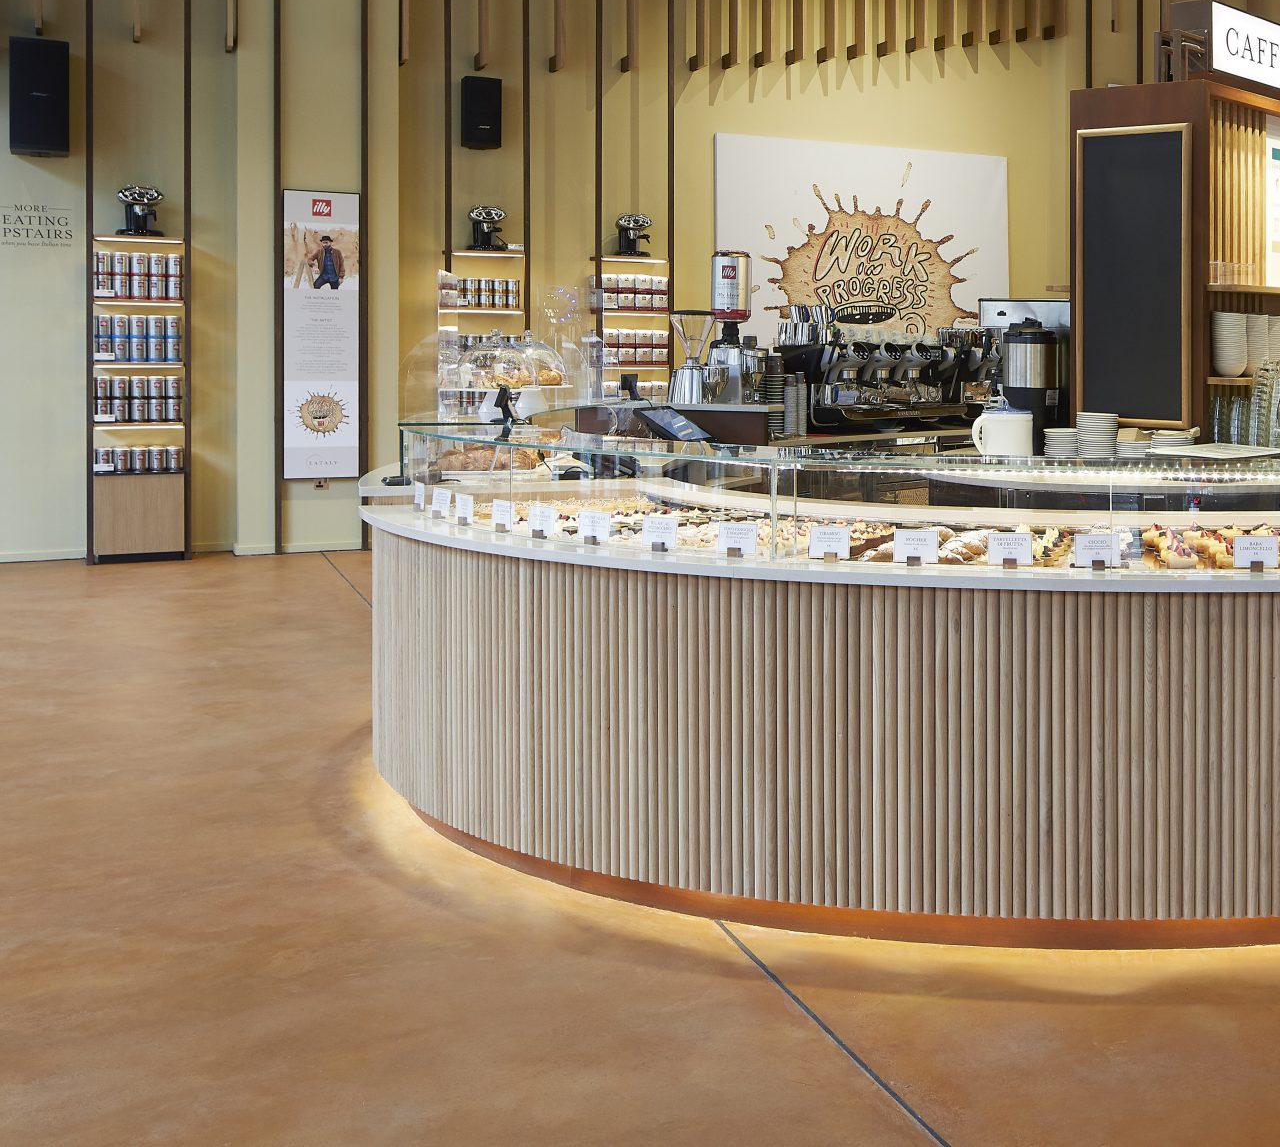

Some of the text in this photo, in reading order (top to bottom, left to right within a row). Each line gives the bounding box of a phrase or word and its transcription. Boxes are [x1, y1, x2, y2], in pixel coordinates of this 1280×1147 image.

[14, 204, 48, 212] MORE
[313, 201, 331, 215] illy
[3, 214, 69, 227] EATING
[813, 227, 932, 283] WORK
[722, 267, 736, 278] illy
[814, 276, 929, 311] PROGRESS
